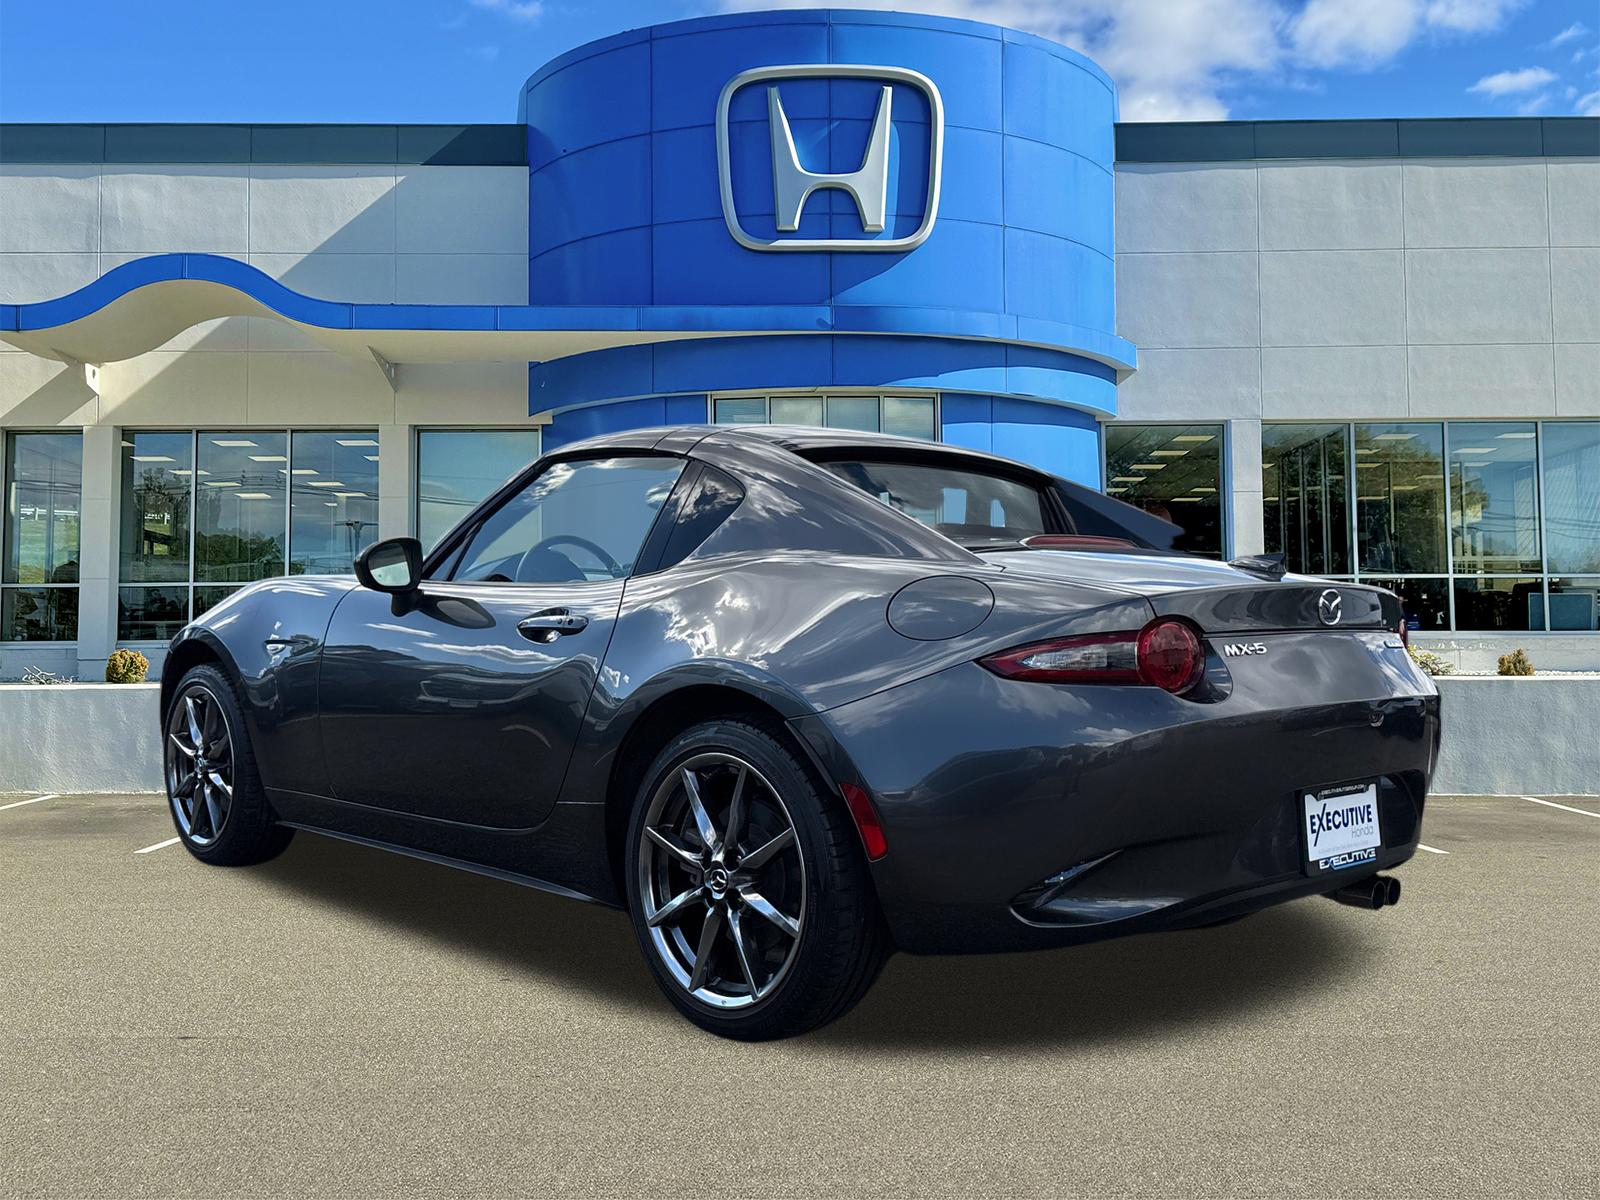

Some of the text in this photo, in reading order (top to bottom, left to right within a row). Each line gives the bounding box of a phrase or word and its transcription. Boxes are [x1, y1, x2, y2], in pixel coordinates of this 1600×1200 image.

[1224, 642, 1267, 657] MX-5
[1310, 803, 1373, 847] EXECUTIVE
[1351, 825, 1374, 839] Honda
[1319, 848, 1376, 869] EXECUTIVE
